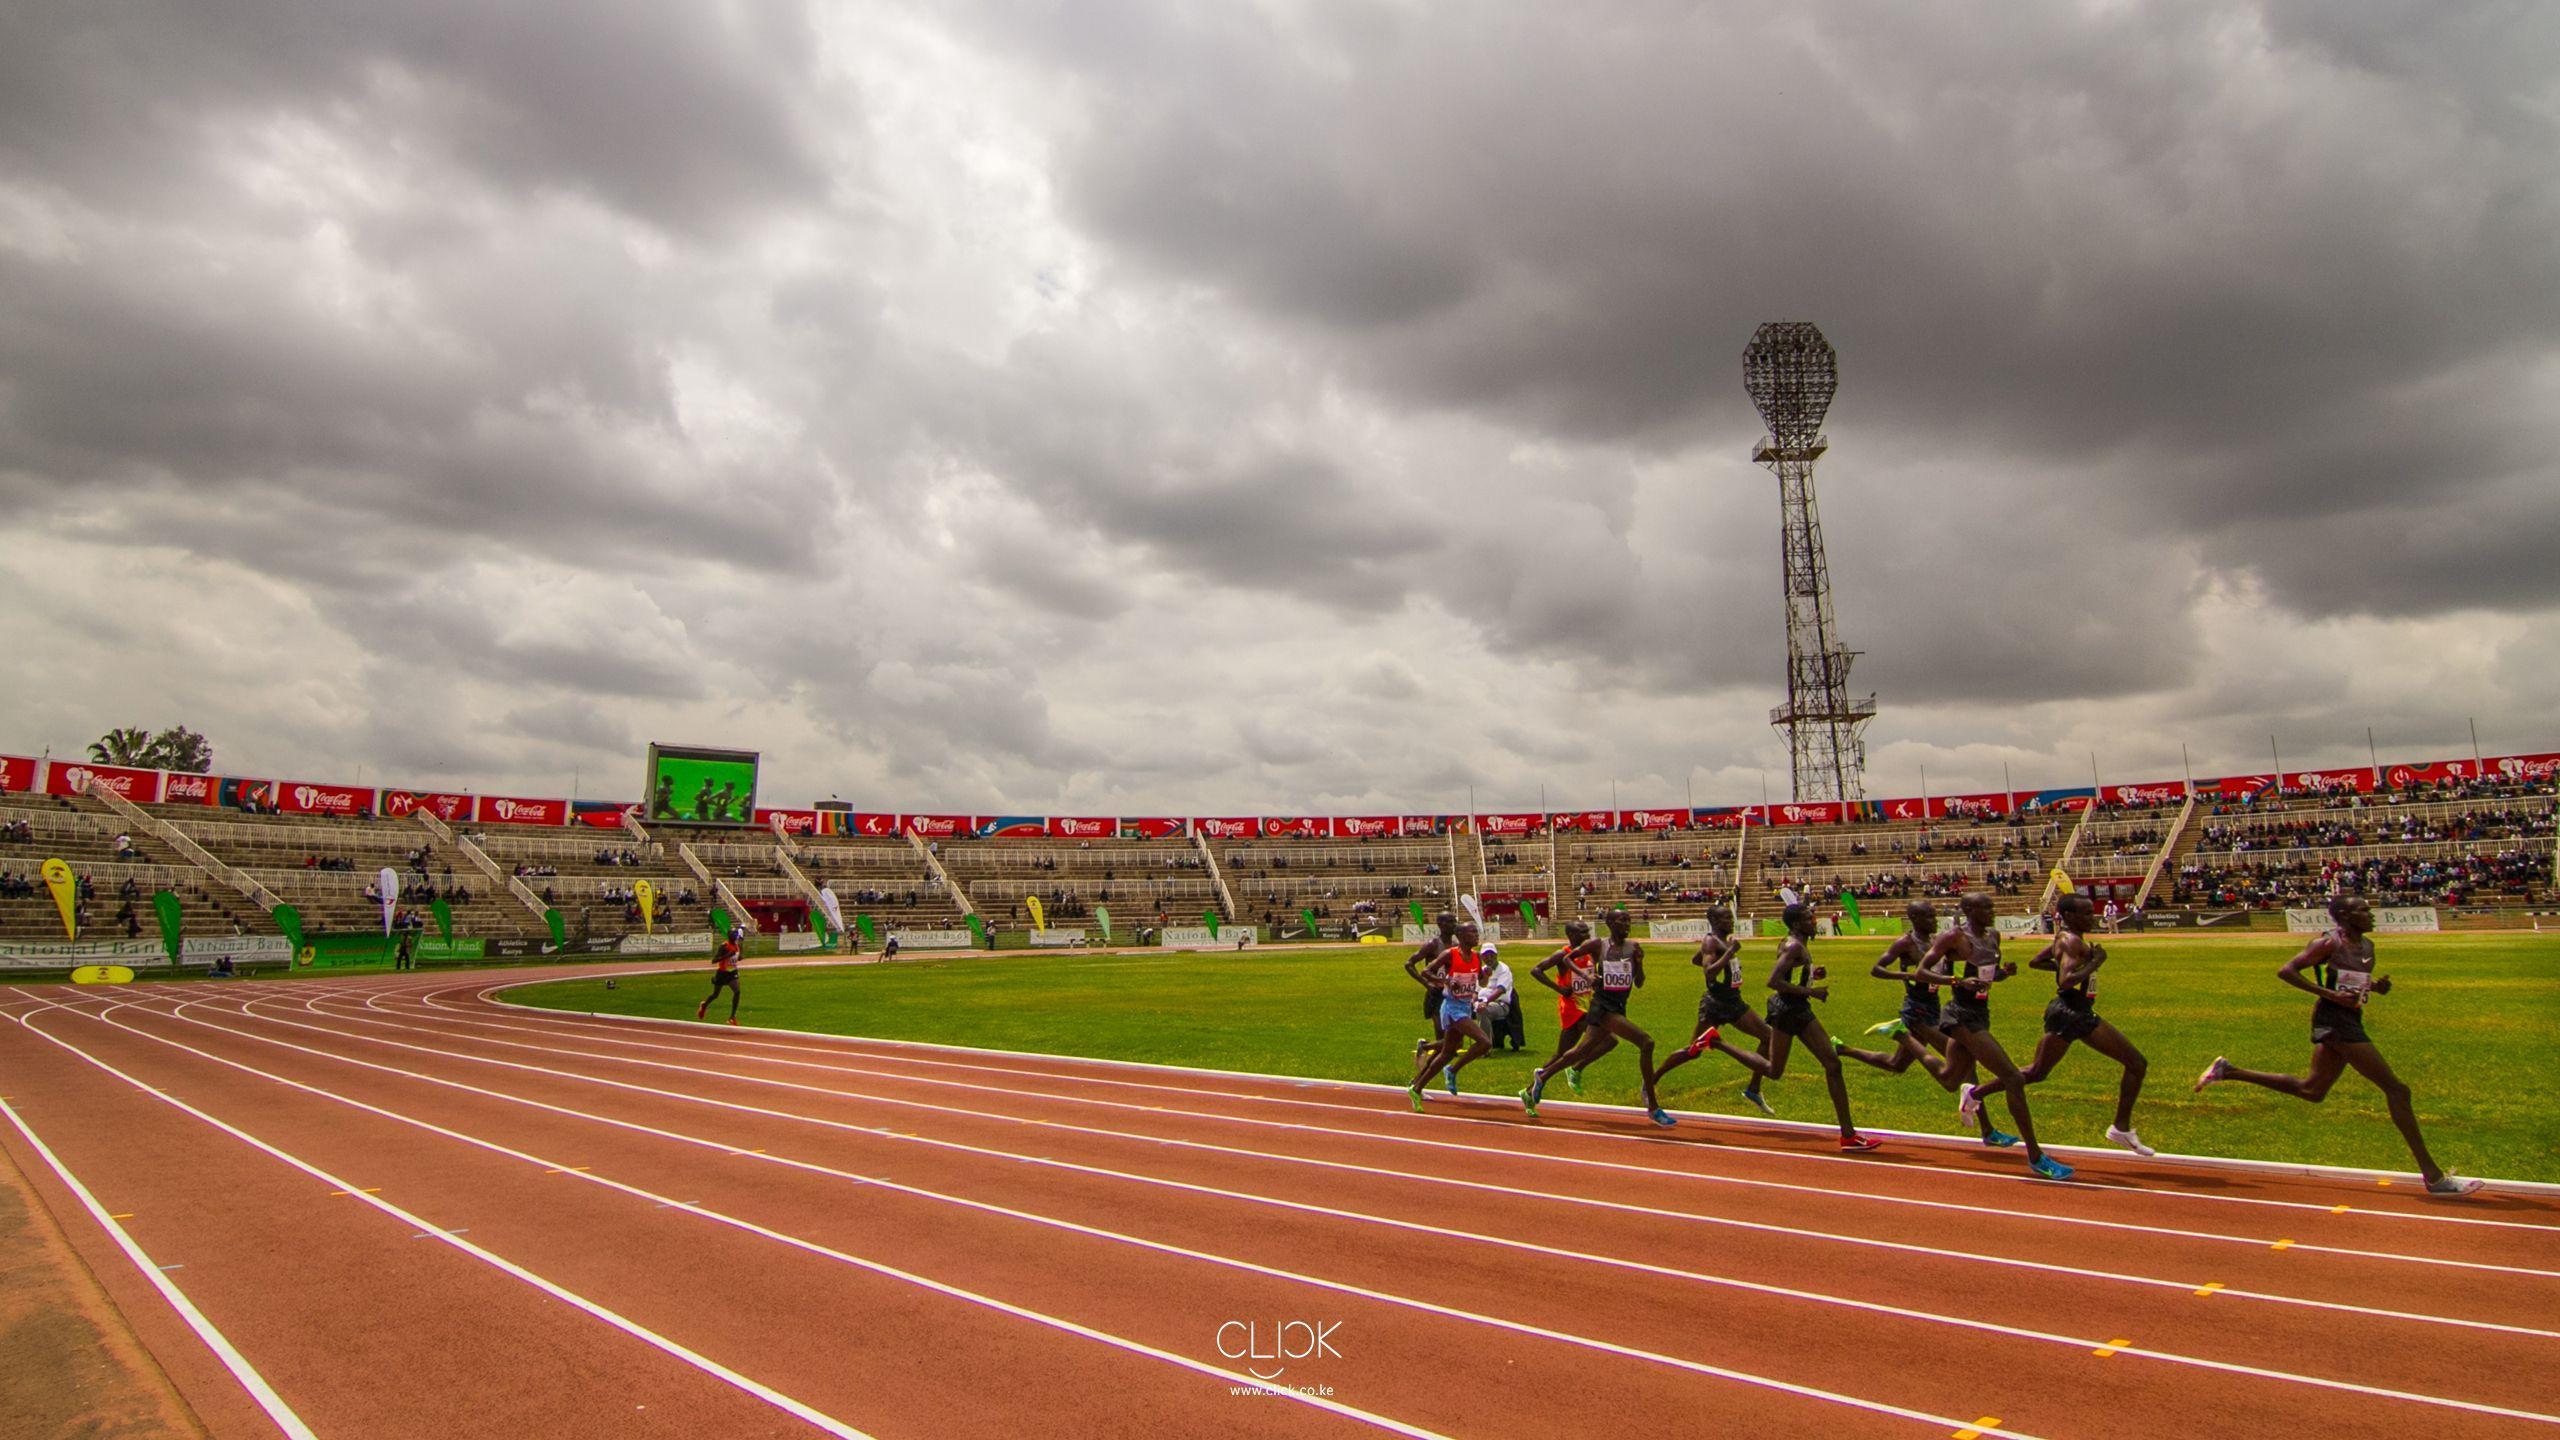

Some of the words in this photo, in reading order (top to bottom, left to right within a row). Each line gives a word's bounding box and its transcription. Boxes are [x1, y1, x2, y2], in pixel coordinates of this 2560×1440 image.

[2290, 910, 2329, 925] Nati
[2385, 910, 2434, 923] Bank
[1654, 923, 1710, 932] National
[2153, 920, 2177, 928] Kenya
[683, 935, 710, 943] Bank
[898, 931, 938, 940] ational
[1164, 930, 1212, 940] Nation
[1225, 927, 1255, 938] Bak
[3, 941, 97, 955] ational
[185, 938, 249, 953] National
[257, 937, 291, 950] Bank
[420, 942, 455, 950] Nationl
[457, 942, 481, 951] Bank
[1605, 973, 1631, 986] 0050
